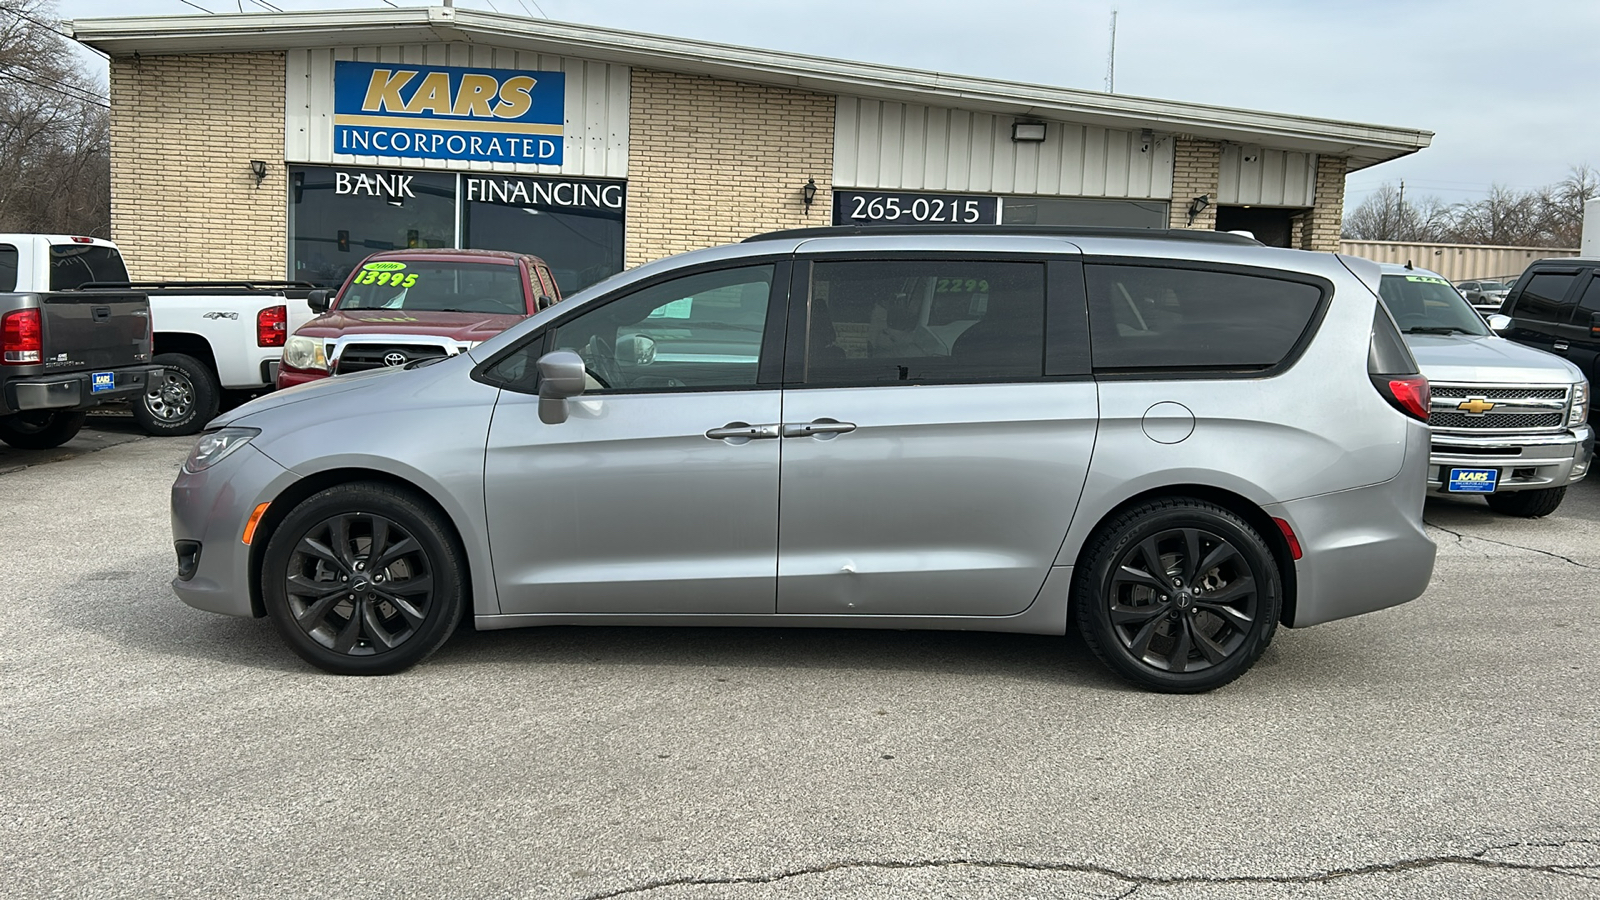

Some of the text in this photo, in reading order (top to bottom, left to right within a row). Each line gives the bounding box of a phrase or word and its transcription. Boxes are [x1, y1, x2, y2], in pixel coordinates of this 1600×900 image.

[361, 68, 538, 119] KARS
[341, 129, 555, 158] INCORPORATED
[335, 172, 622, 208] BANK FINANCING
[850, 196, 980, 223] 265-0215
[353, 270, 419, 288] 13995
[936, 279, 988, 292] 2299
[1458, 472, 1488, 481] KARS
